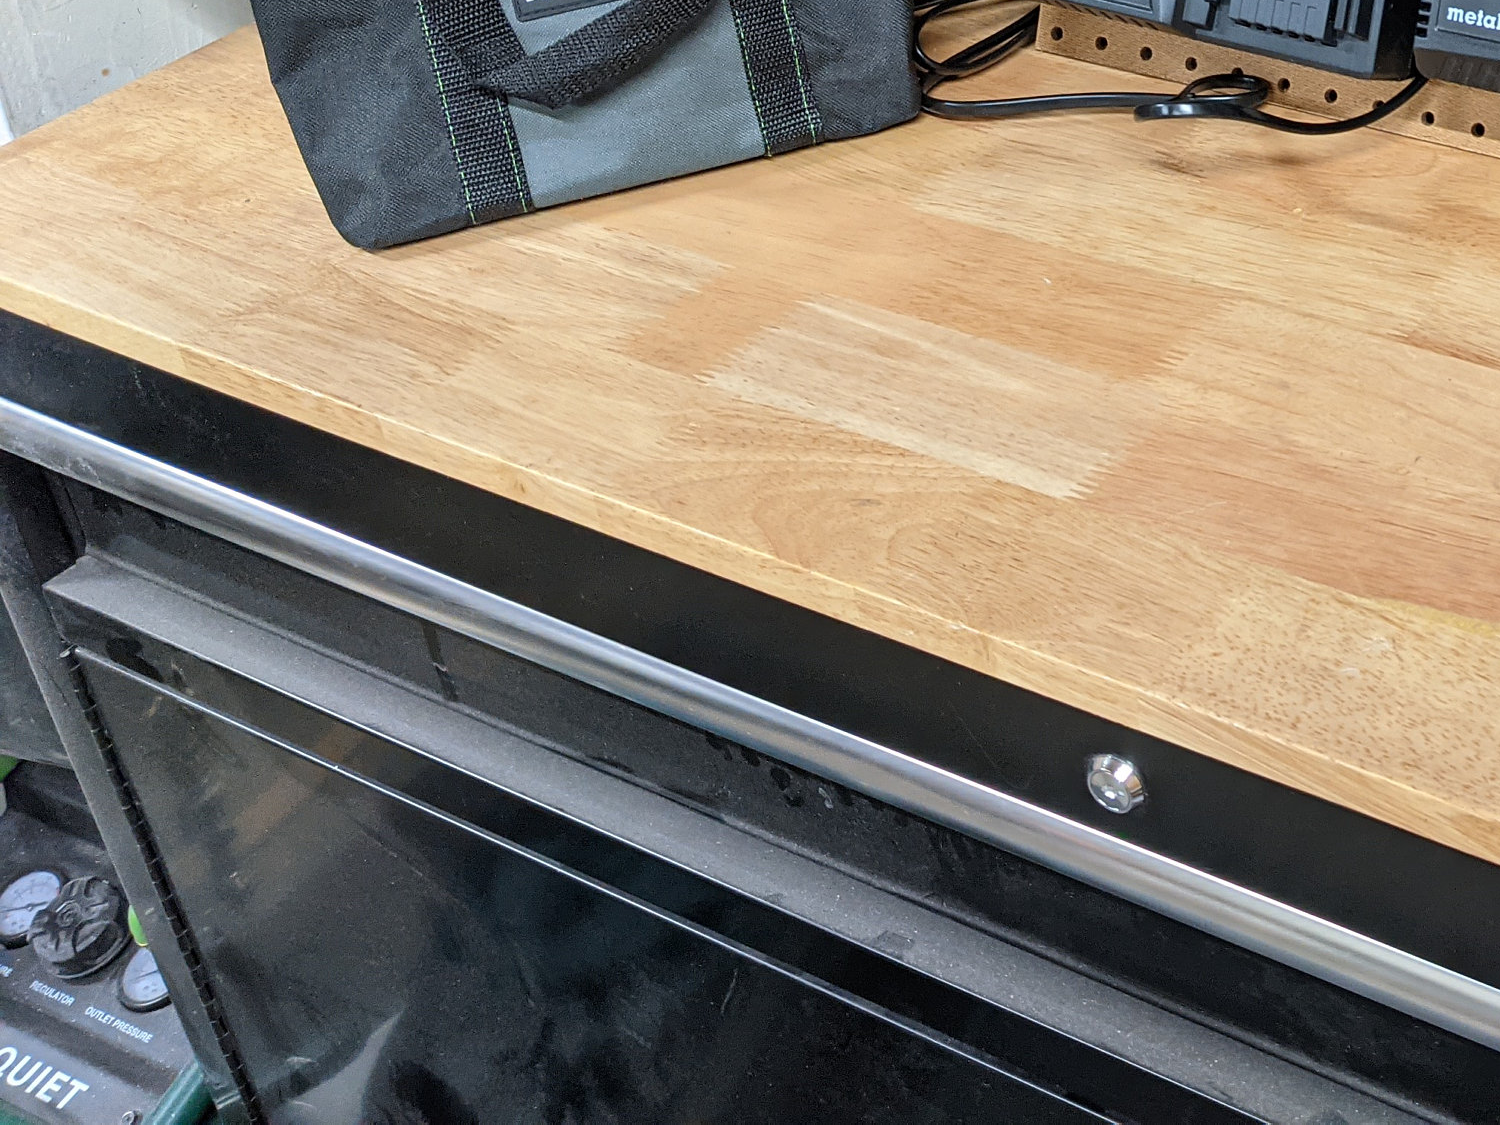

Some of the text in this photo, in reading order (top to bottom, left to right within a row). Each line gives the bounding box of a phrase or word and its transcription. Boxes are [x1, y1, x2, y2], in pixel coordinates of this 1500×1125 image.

[29, 980, 75, 1006] REGULATOR
[85, 1006, 154, 1043] OUTLET PRESSURE
[0, 1046, 90, 1109] QUIET
